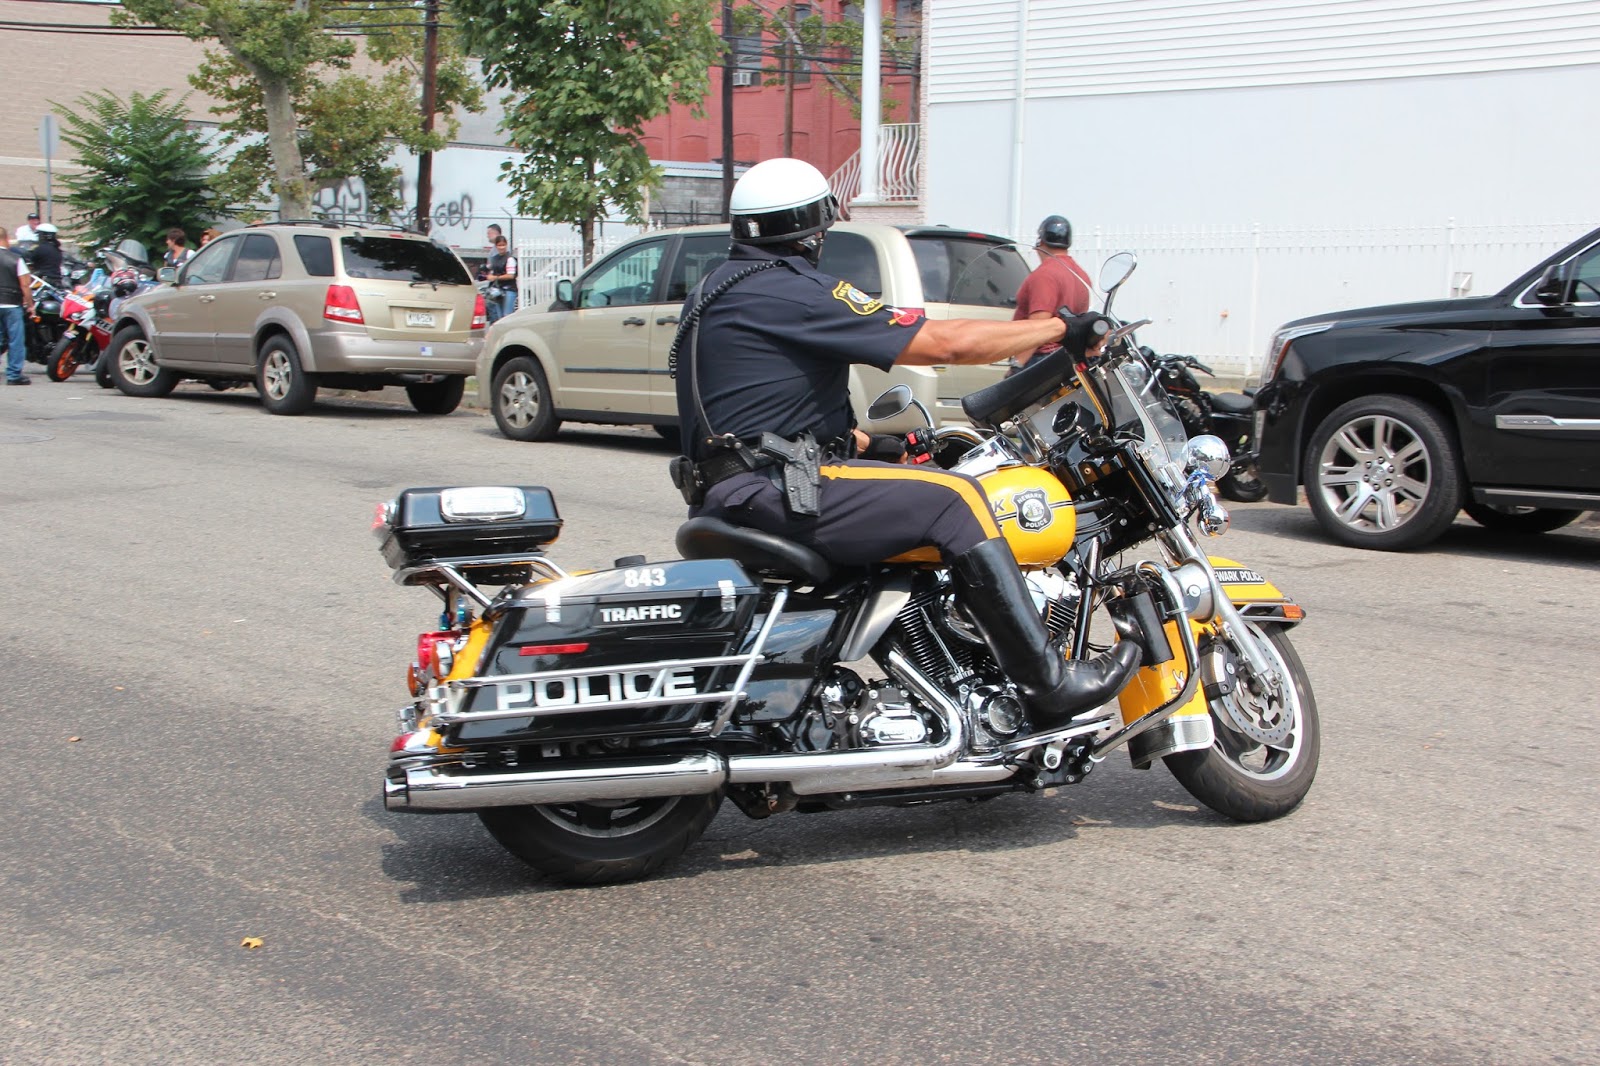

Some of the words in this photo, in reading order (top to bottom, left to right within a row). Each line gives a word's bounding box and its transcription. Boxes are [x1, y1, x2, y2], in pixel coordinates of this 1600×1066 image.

[1017, 493, 1043, 504] NEWARK
[1025, 518, 1048, 528] POLICE
[624, 567, 667, 588] 843
[599, 603, 682, 623] TRAFFIC
[497, 666, 698, 711] POLICE
